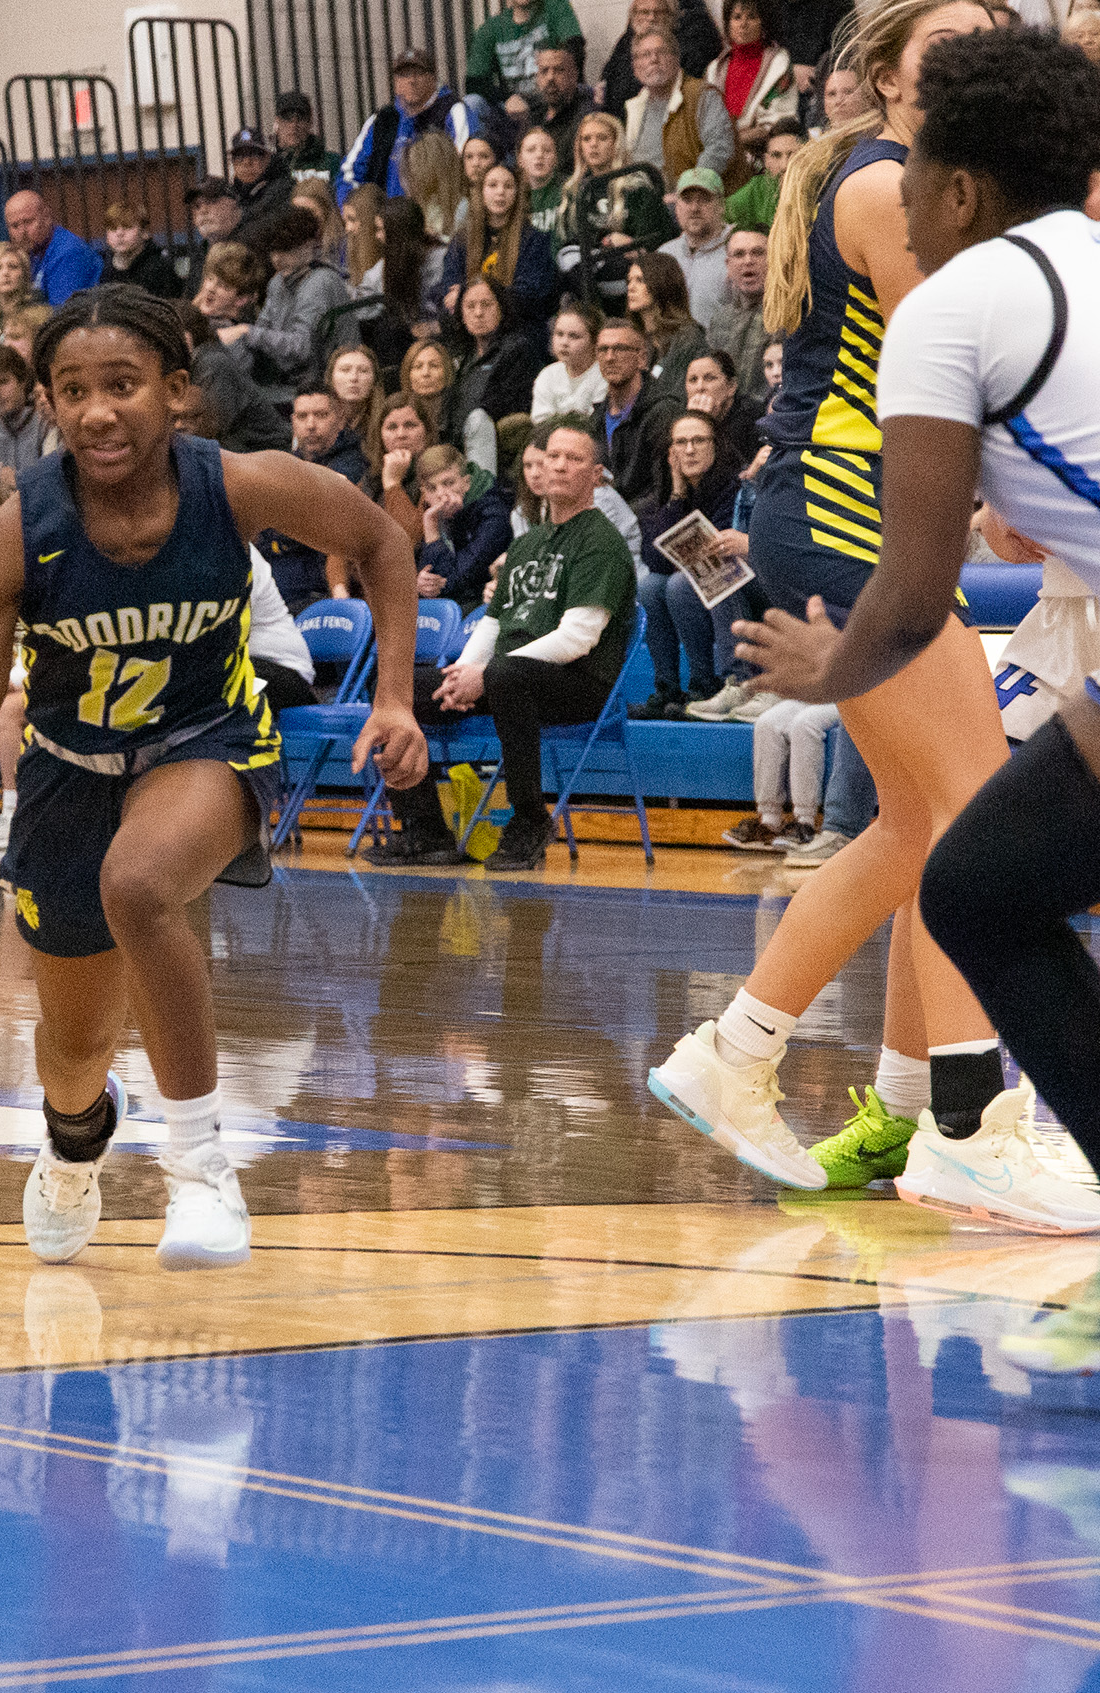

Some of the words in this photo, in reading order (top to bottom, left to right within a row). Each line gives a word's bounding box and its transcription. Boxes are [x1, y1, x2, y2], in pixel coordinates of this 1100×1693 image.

[297, 615, 321, 632] AKE
[417, 615, 441, 632] ENTON
[78, 648, 172, 732] 12
